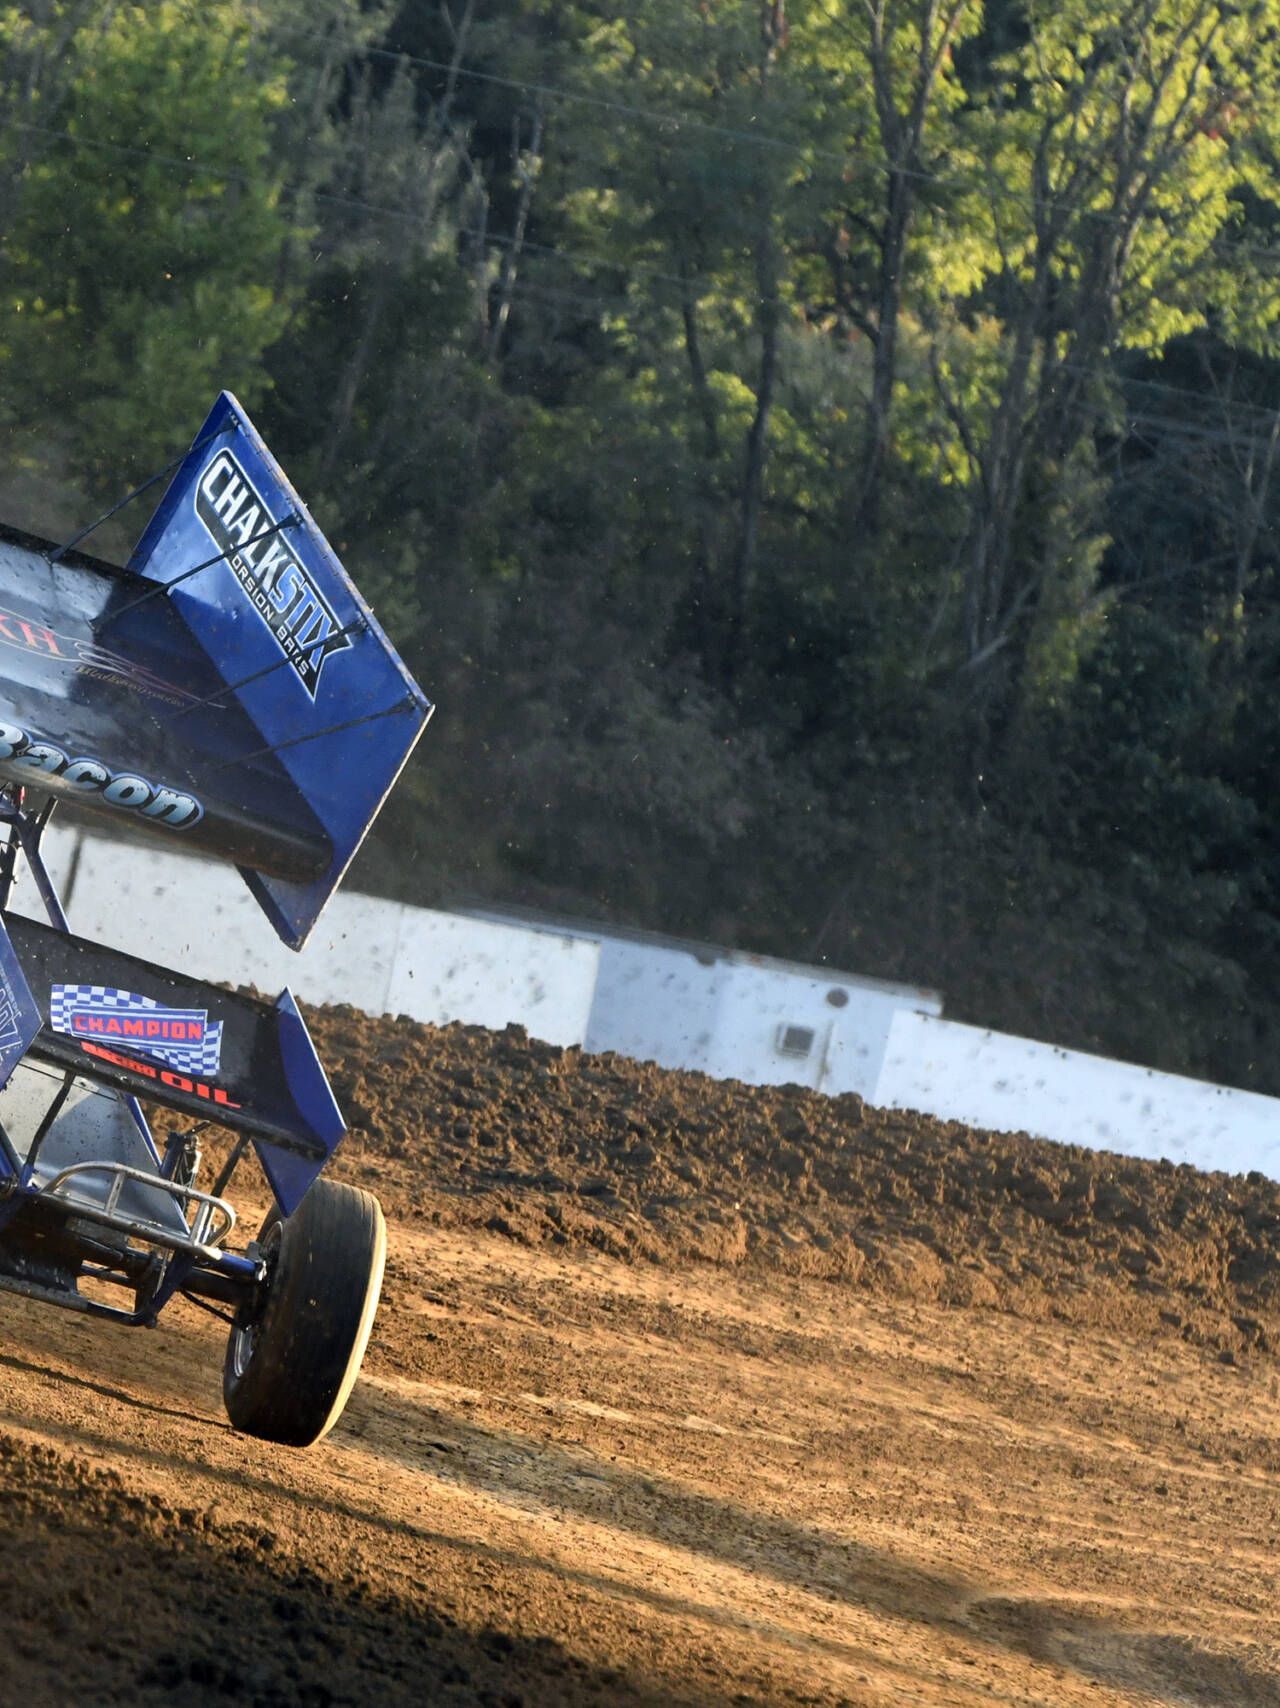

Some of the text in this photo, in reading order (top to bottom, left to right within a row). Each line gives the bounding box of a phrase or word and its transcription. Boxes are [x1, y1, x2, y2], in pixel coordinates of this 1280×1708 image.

[202, 456, 339, 673] CHALKSTIX
[229, 544, 275, 621] ORSION
[74, 1015, 202, 1040] CHAMPION
[161, 1071, 241, 1109] OIL
